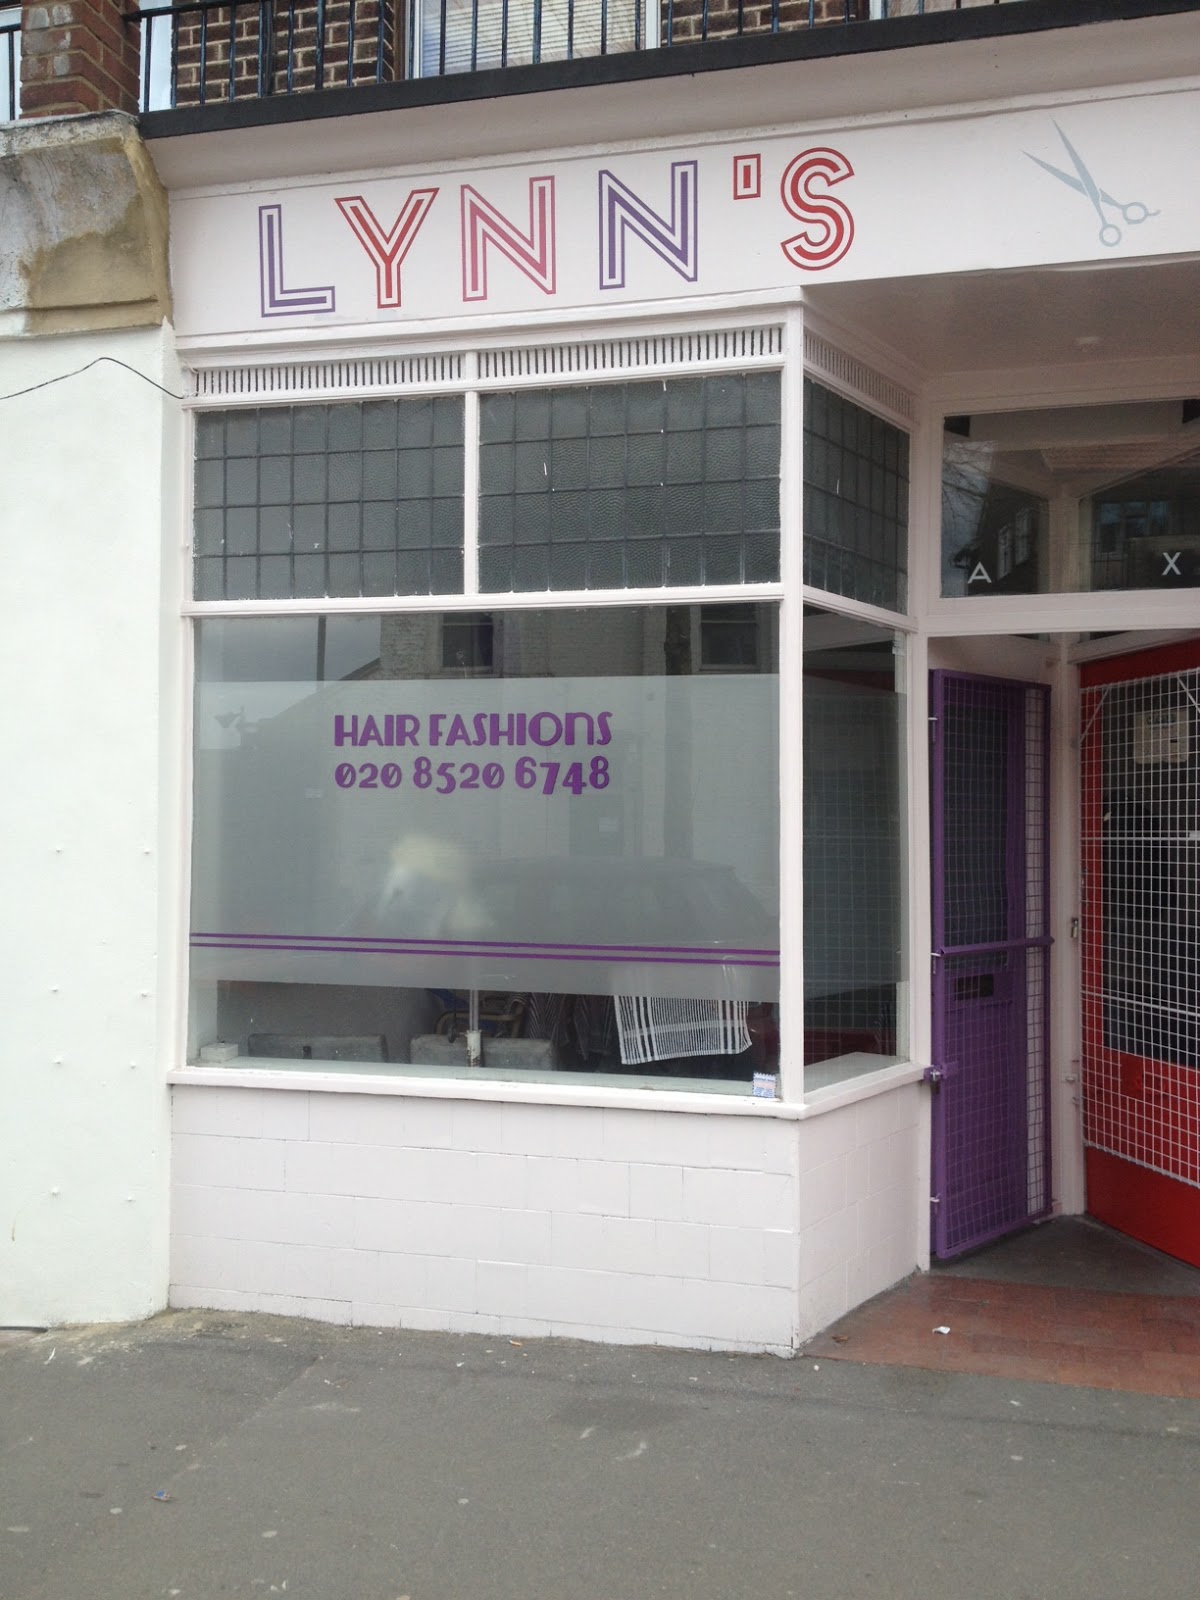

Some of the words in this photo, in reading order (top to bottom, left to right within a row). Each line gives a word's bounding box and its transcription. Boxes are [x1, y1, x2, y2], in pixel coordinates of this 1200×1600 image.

[258, 147, 856, 317] LYNN'S
[967, 561, 992, 584] A
[1161, 552, 1182, 576] X
[334, 714, 421, 746] HAIR
[335, 762, 402, 788] 020
[413, 756, 505, 794] 8520
[515, 755, 610, 794] 6748
